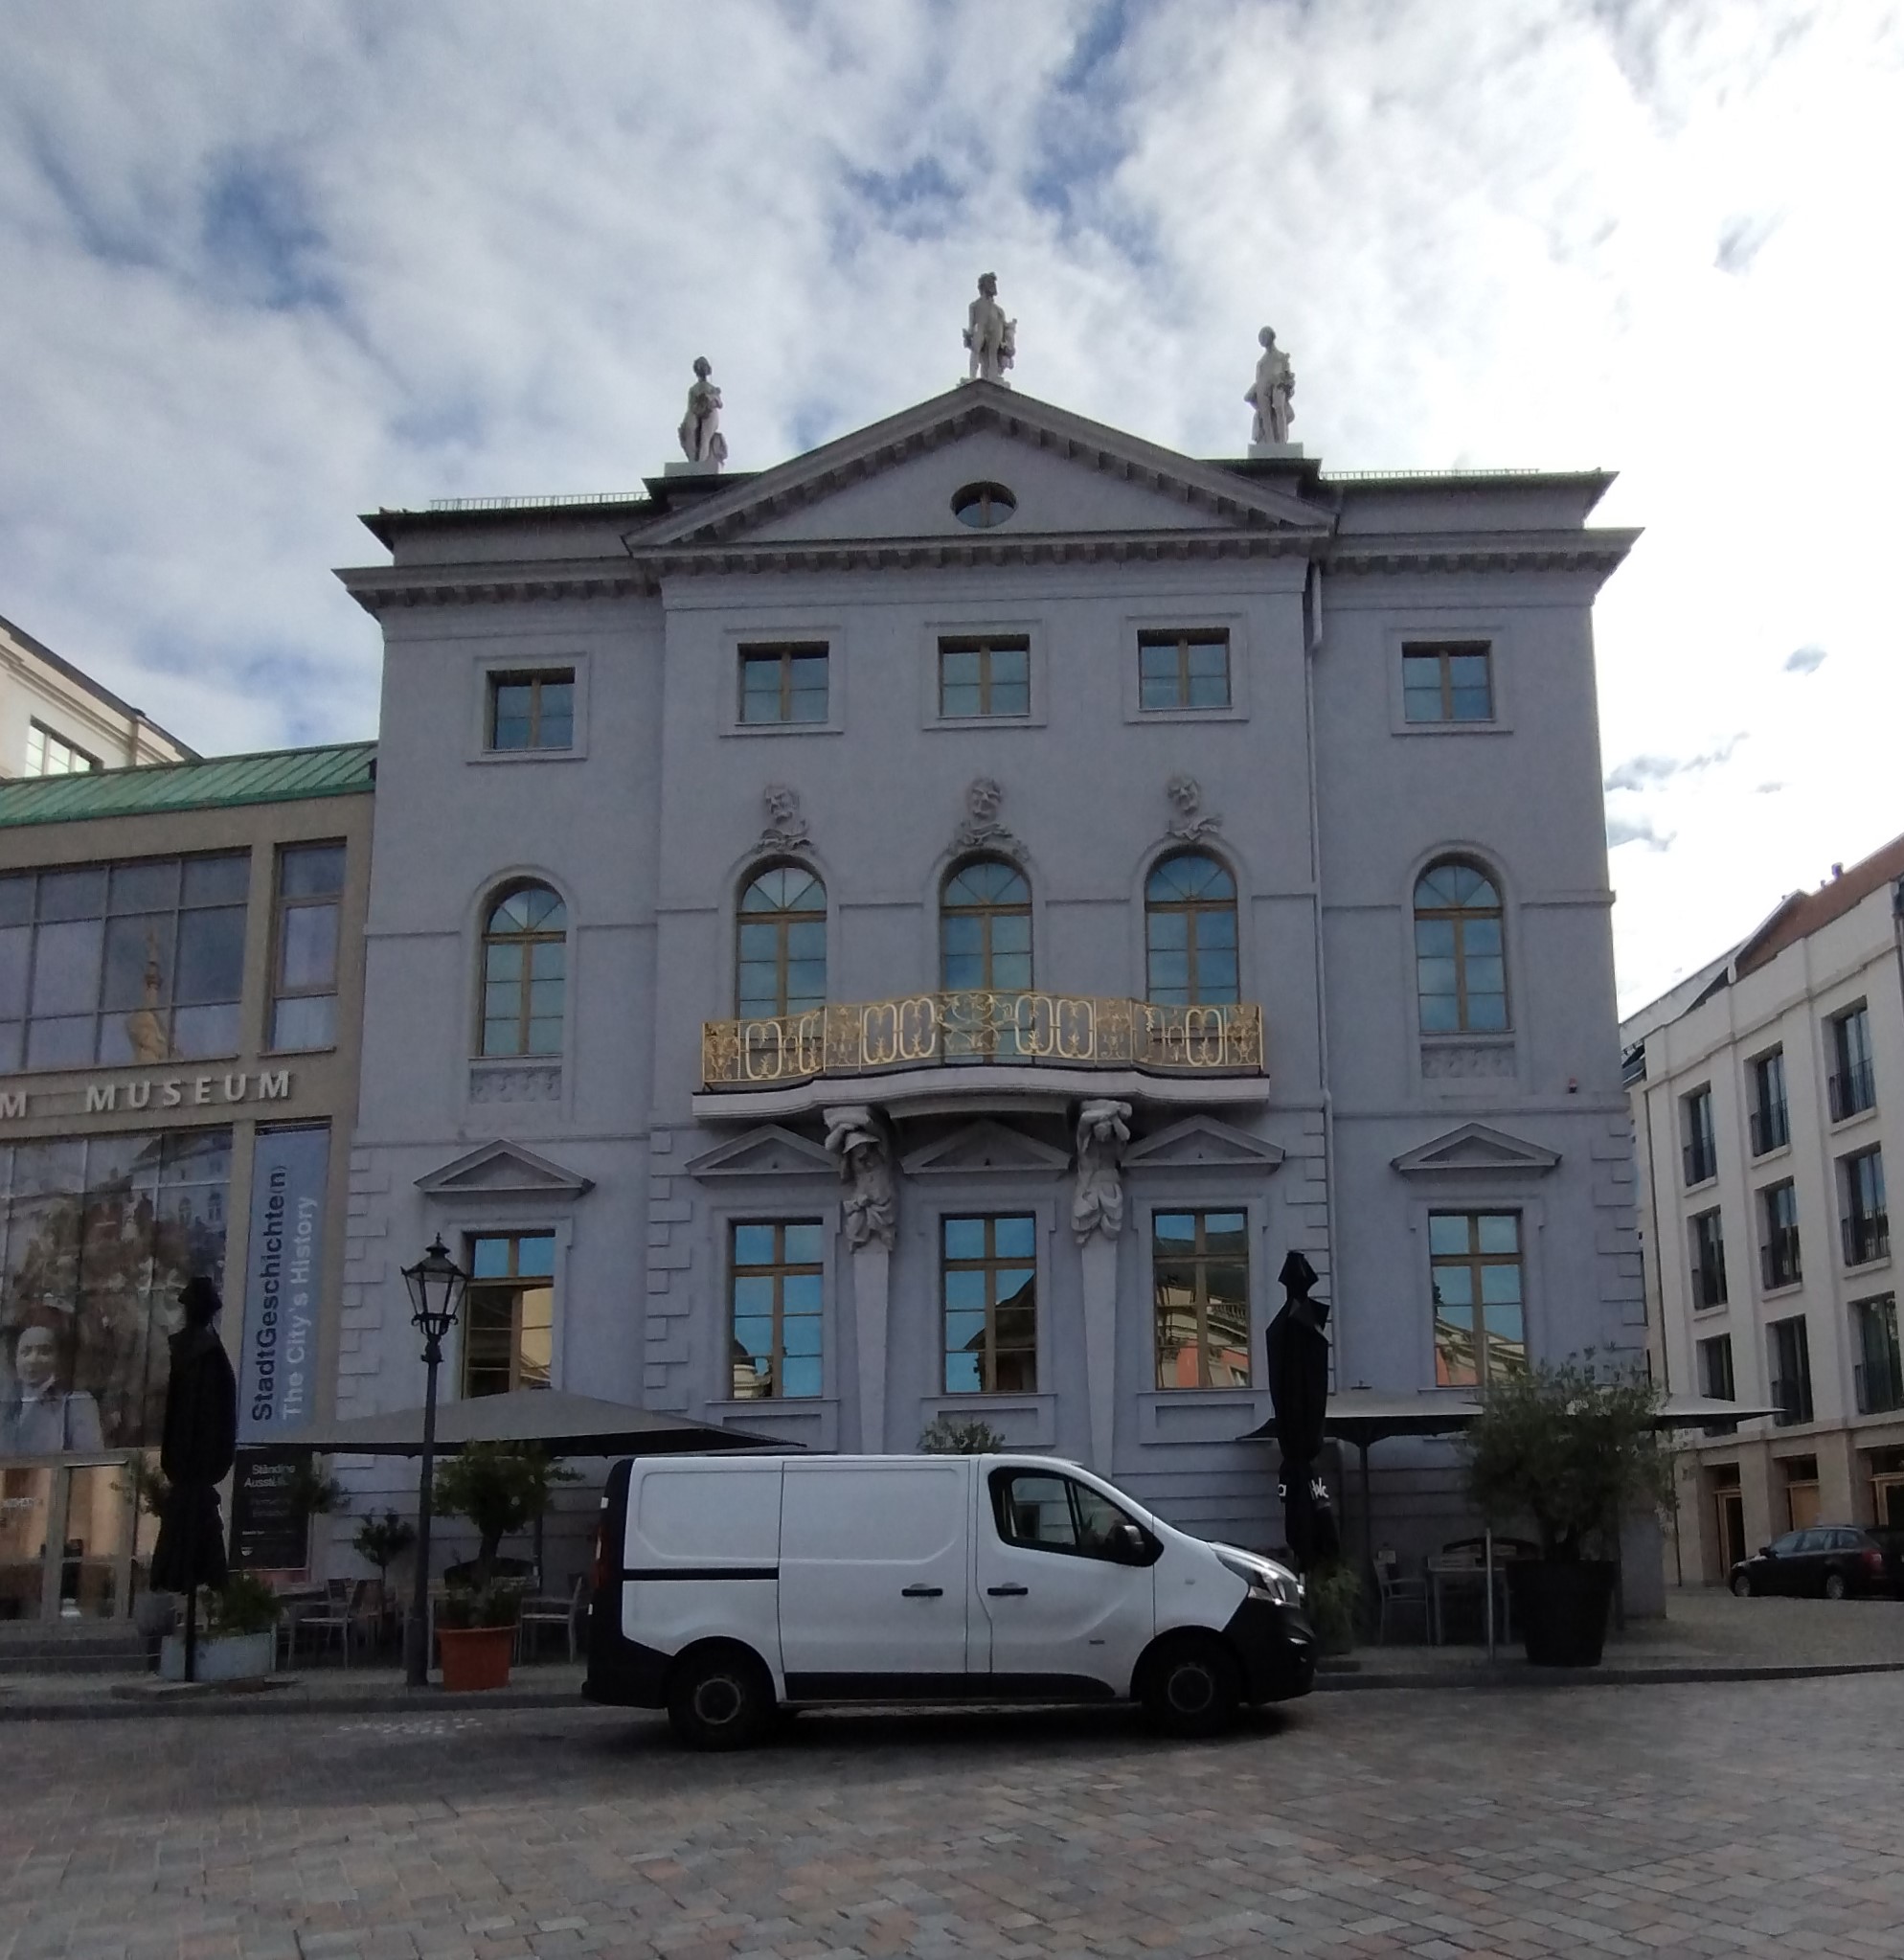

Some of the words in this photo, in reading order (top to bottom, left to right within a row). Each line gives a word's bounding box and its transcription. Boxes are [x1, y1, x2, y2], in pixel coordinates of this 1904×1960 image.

[85, 1069, 290, 1113] MUSEUM
[290, 1196, 318, 1285] History
[283, 1371, 305, 1420] The
